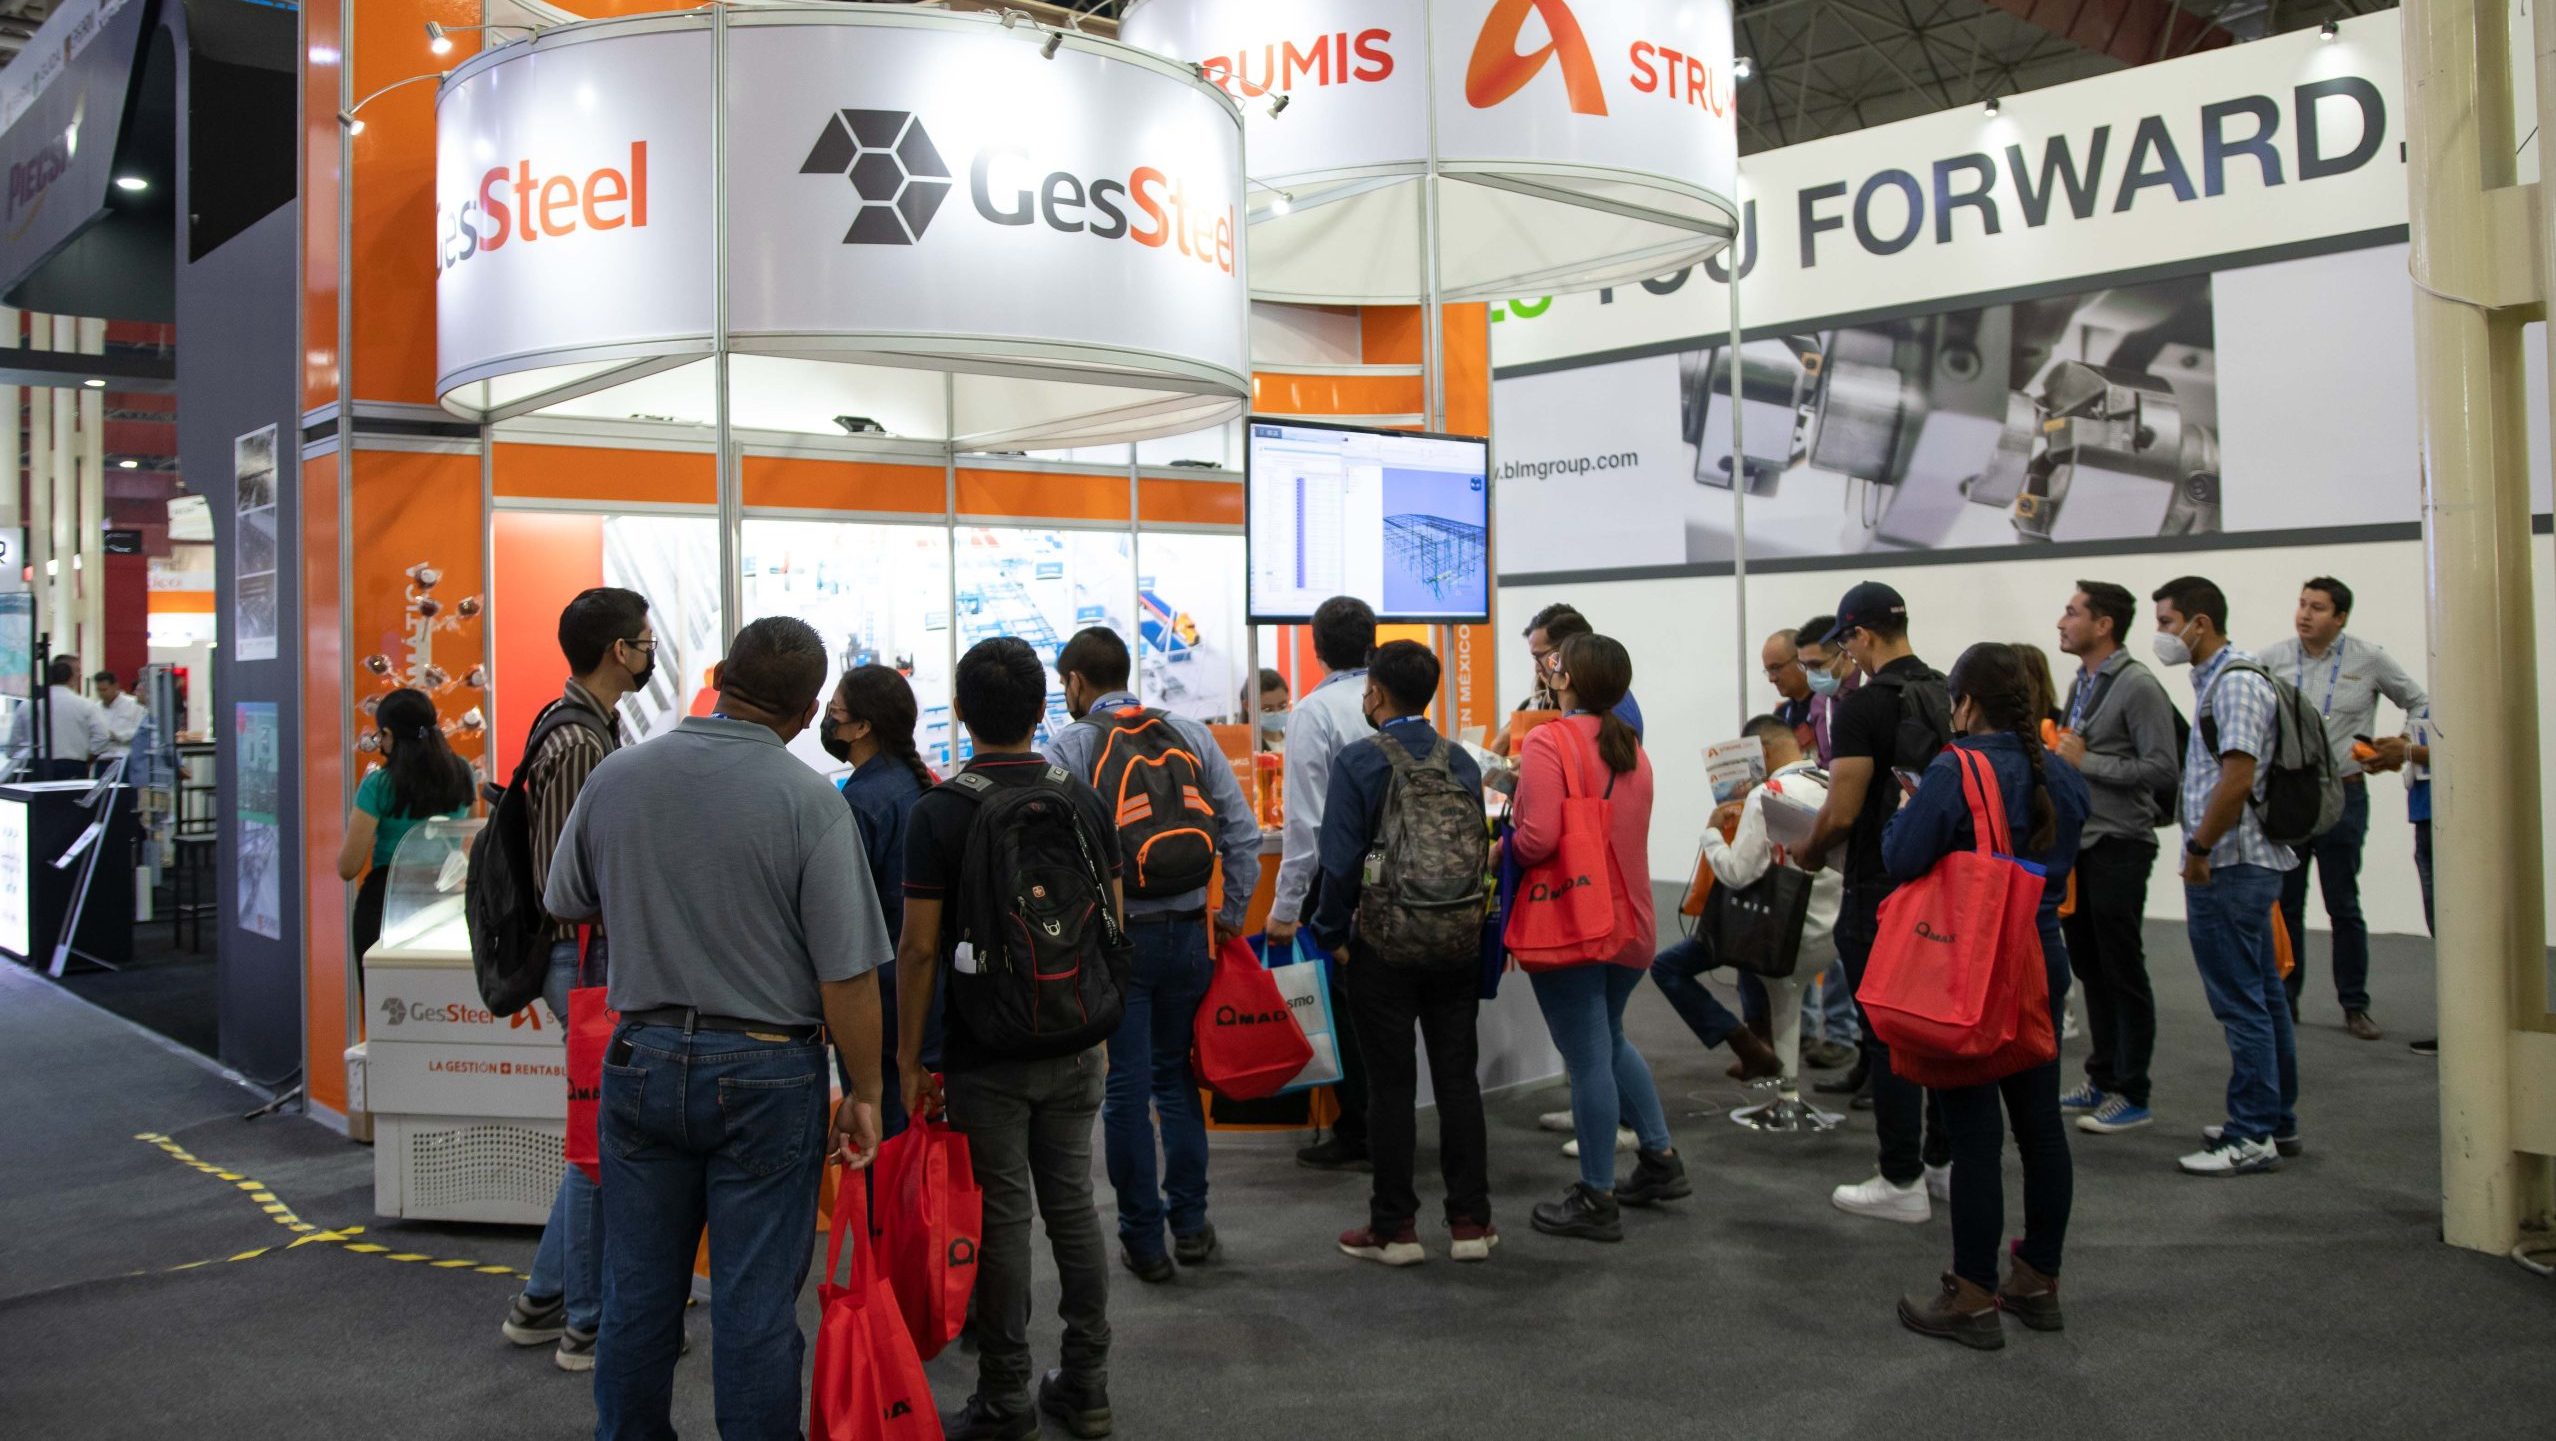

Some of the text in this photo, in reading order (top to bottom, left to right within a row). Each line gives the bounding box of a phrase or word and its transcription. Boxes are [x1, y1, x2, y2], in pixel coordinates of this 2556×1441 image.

[970, 147, 1235, 278] GesSteel
[1458, 624, 1471, 702] MÉXICO
[429, 1061, 443, 1072] LA
